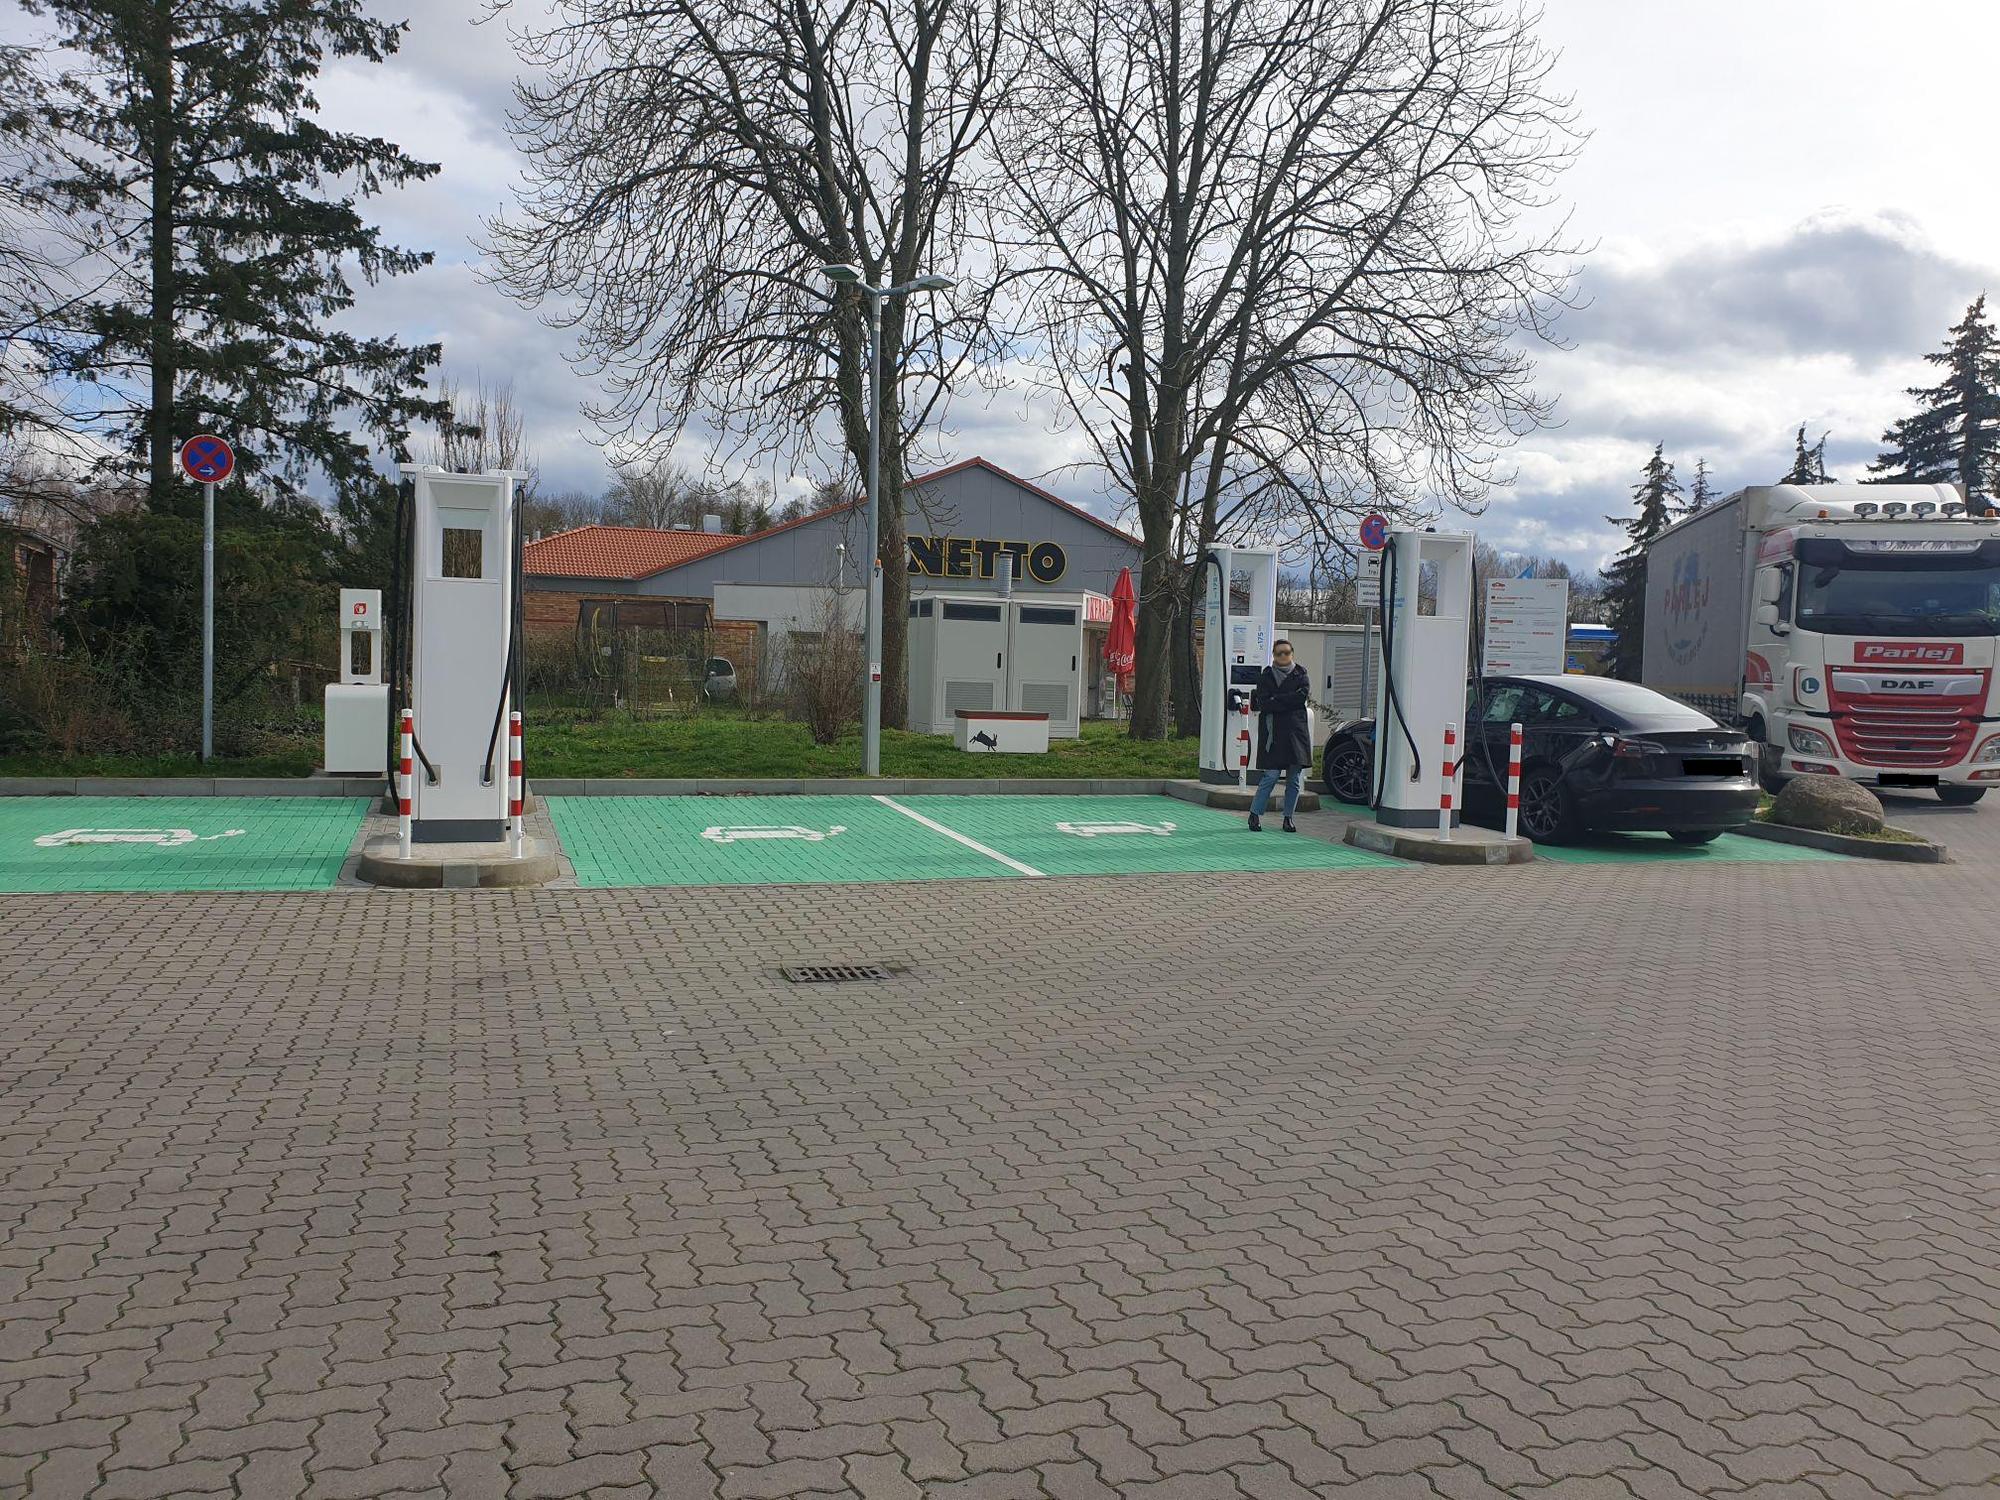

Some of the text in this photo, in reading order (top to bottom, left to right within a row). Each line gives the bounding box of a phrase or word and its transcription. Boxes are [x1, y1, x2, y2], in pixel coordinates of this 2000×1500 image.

[908, 535, 1068, 583] NETTO
[1863, 645, 1955, 661] Parlej
[1805, 680, 1816, 692] L
[1880, 679, 1934, 689] DAF
